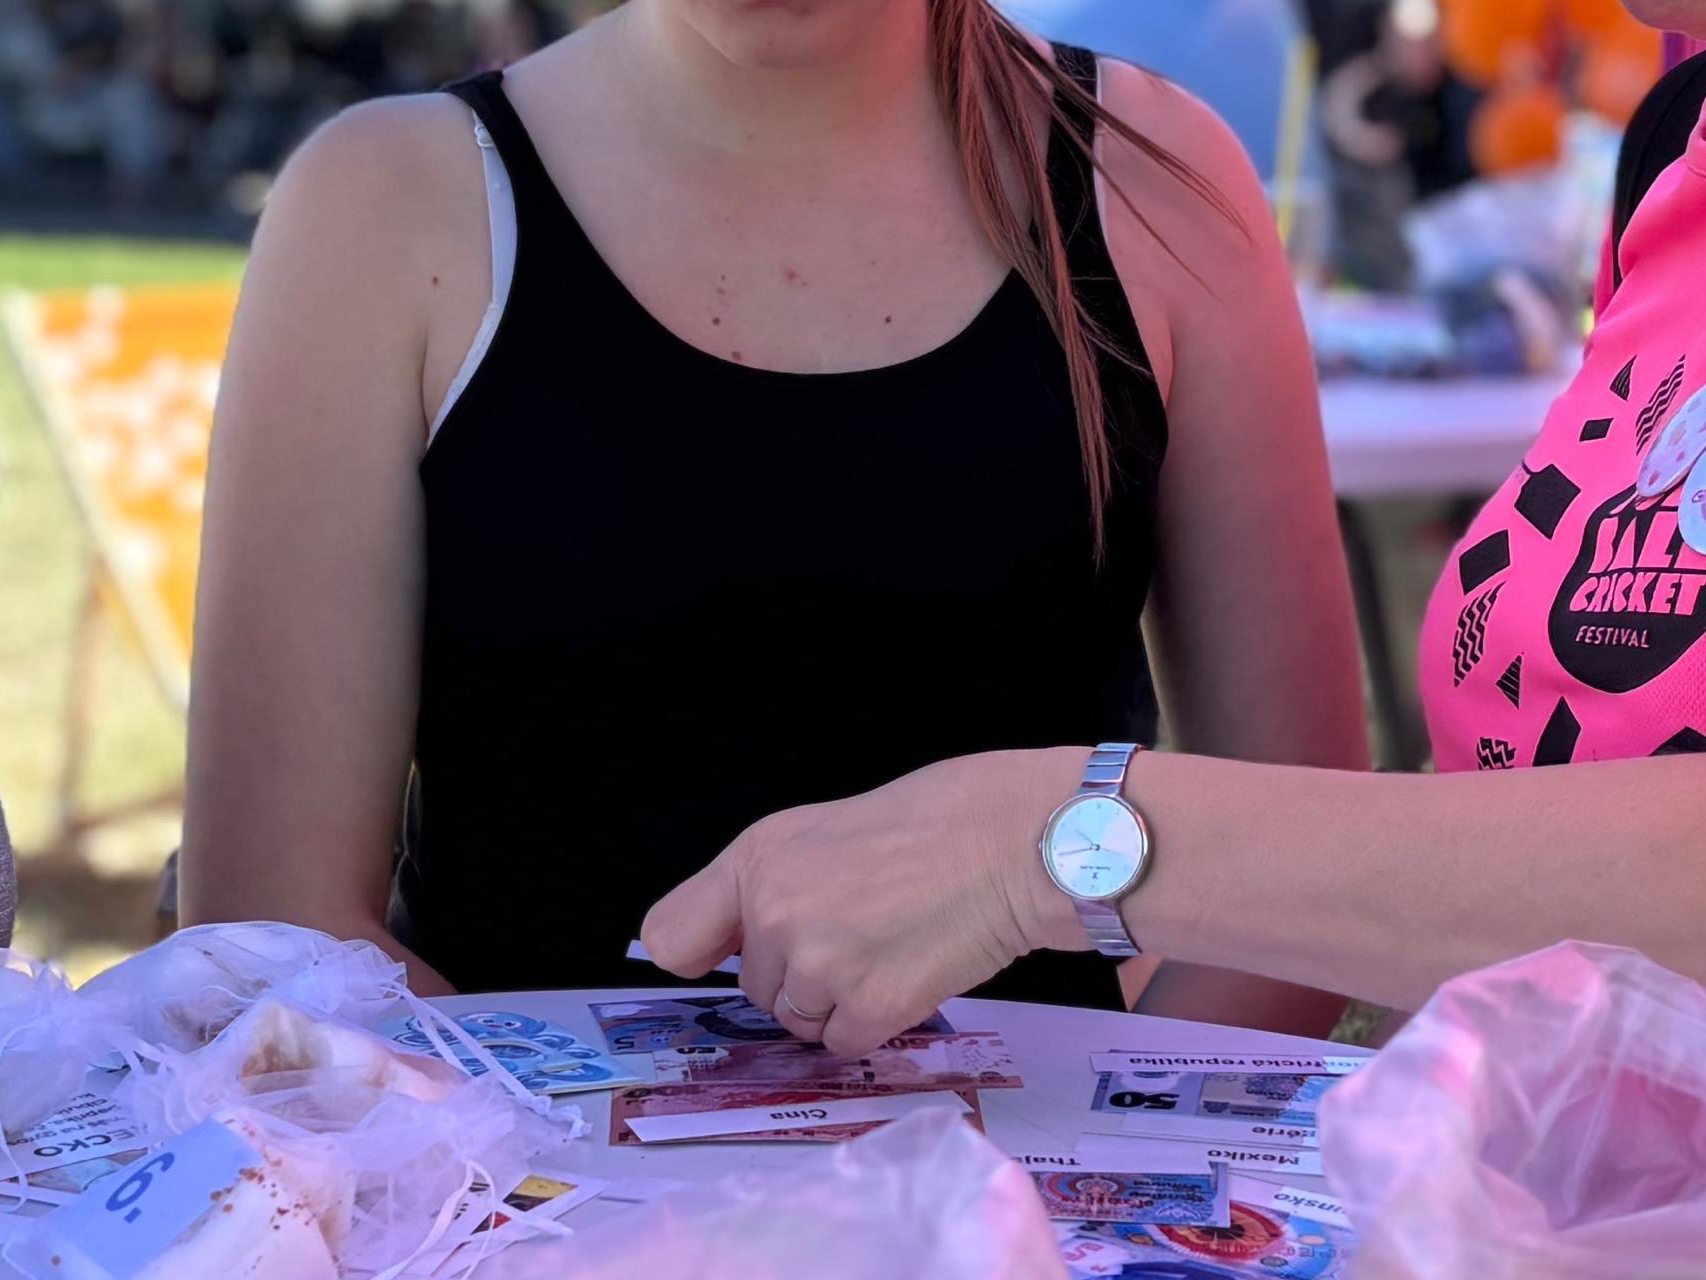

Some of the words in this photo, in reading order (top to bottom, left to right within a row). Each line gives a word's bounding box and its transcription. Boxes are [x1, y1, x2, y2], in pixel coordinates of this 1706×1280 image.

[1575, 625, 1651, 649] FESTIVAL
[1128, 1056, 1246, 1067] republika
[1108, 1090, 1180, 1110] 50
[769, 1108, 828, 1121] Čína
[34, 1123, 149, 1157] ECKO
[1013, 1152, 1082, 1166] Thaj
[1207, 1148, 1301, 1166] Mexiko
